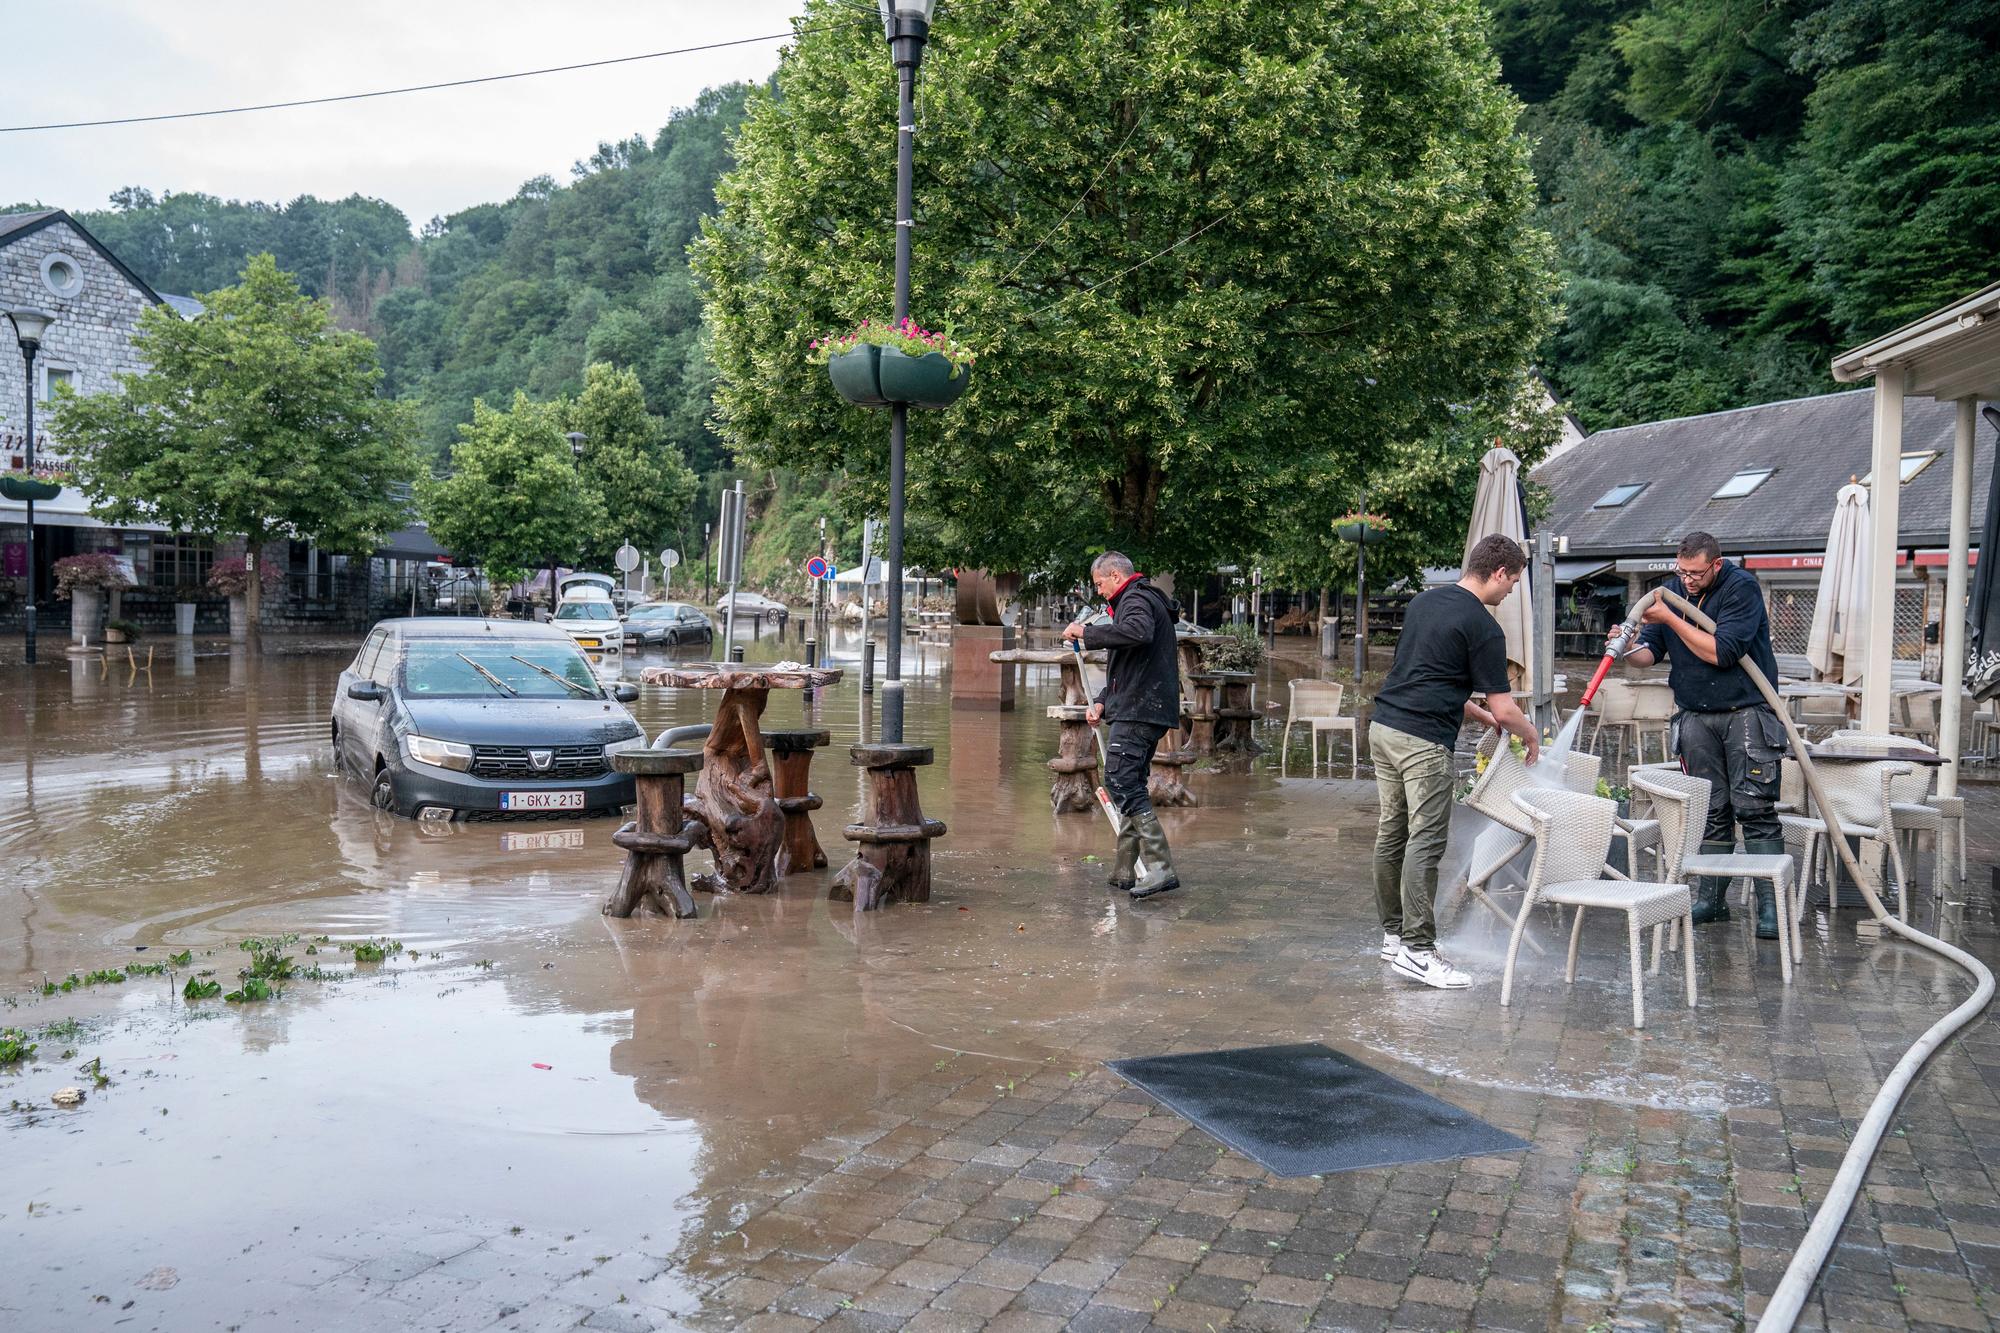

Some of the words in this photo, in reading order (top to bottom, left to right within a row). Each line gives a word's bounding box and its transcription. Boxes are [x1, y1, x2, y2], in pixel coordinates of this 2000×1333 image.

[33, 460, 78, 474] RASSERI
[1648, 563, 1667, 571] CASA
[512, 795, 582, 807] 1-GKX-213
